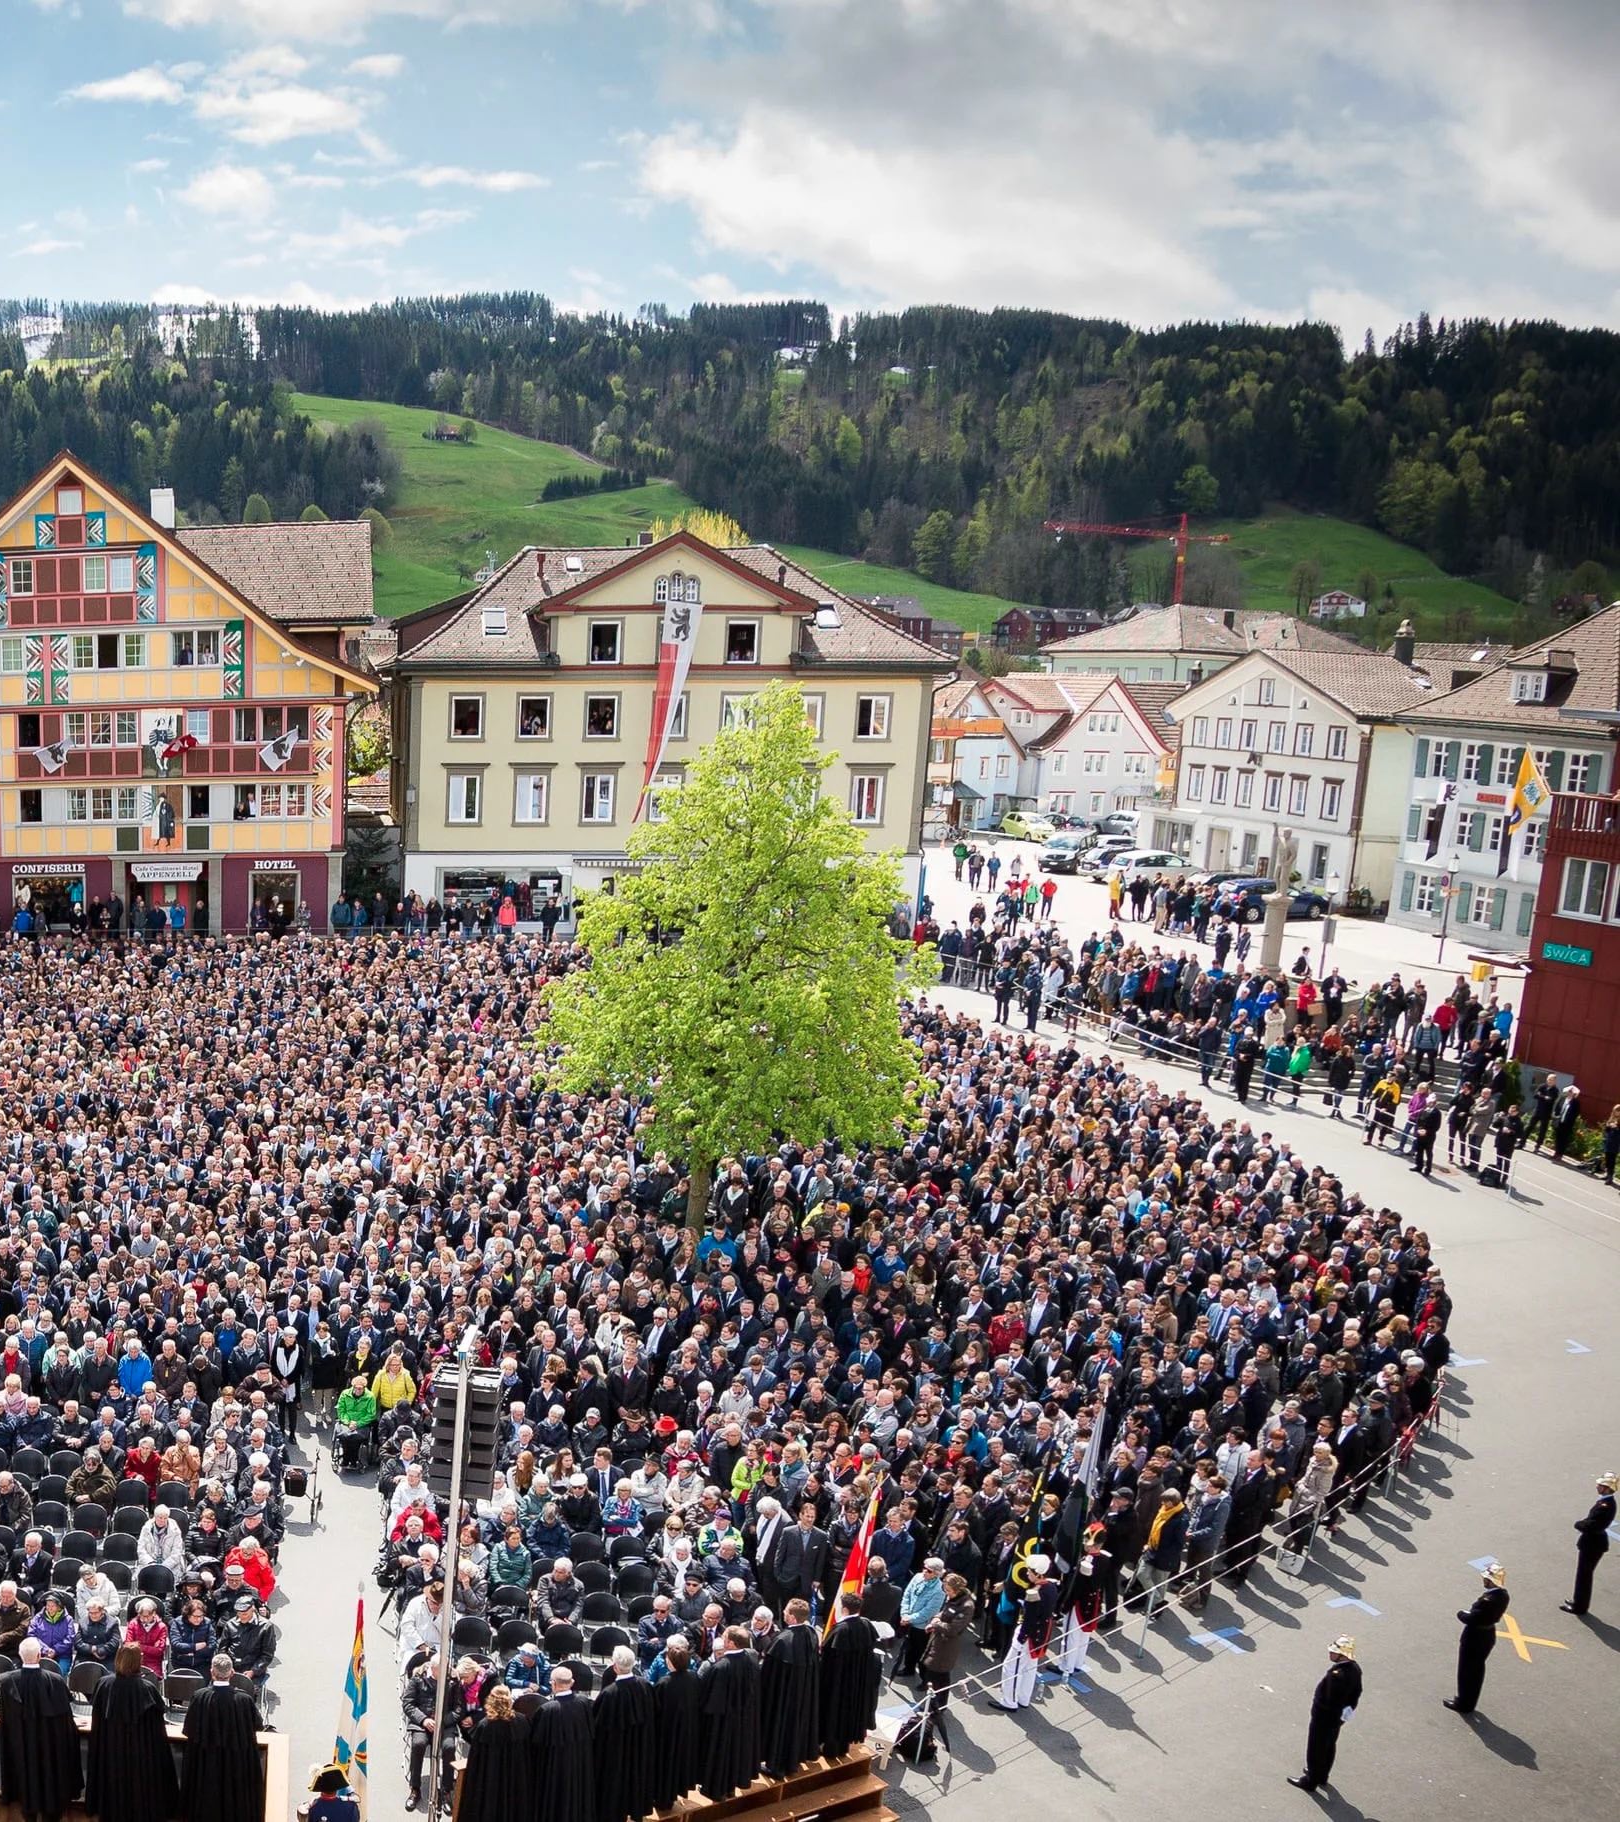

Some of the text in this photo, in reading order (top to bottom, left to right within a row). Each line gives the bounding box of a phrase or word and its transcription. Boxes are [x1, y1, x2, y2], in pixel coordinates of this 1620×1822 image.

[12, 863, 85, 874] CONFISERIE
[254, 860, 296, 870] HOTEL
[140, 871, 194, 879] APPENZELL
[1545, 944, 1588, 962] SWICA
